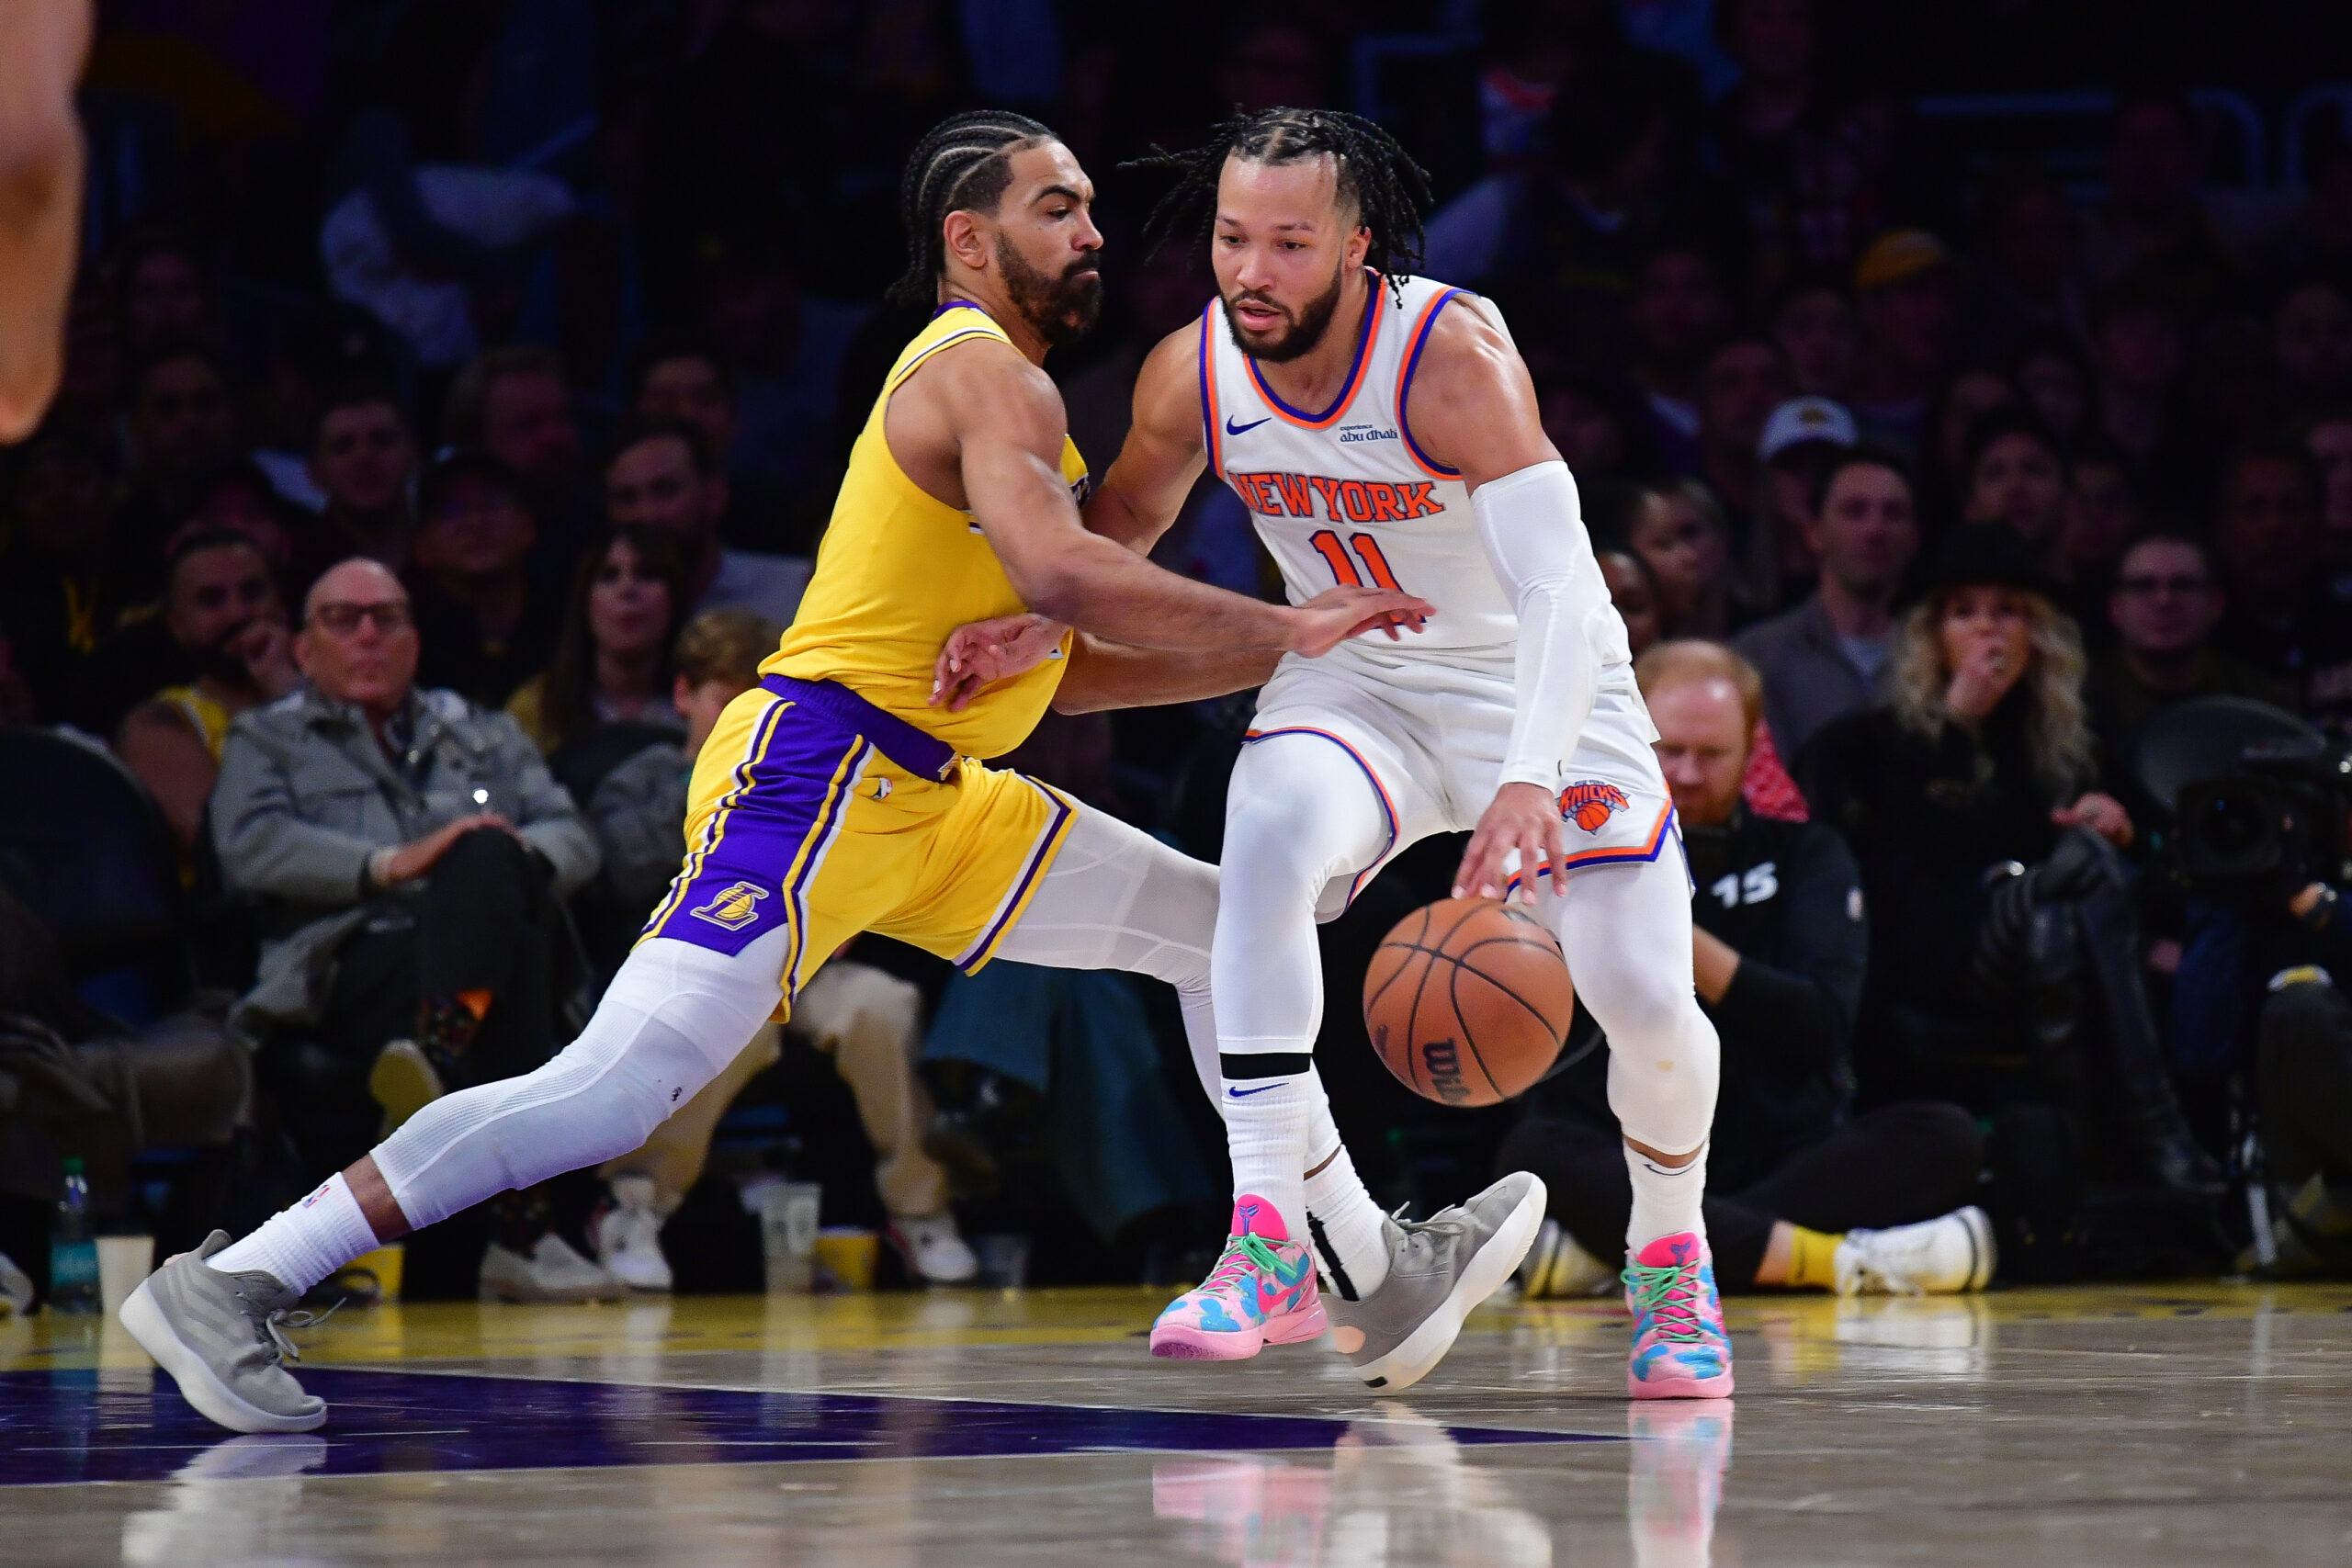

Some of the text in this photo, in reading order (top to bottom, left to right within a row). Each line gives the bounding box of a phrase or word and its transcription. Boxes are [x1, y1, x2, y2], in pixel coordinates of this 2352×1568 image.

[1340, 428, 1398, 442] abu dhabi
[1228, 471, 1446, 523] NEW YORK
[1559, 784, 1630, 816] KNICKS
